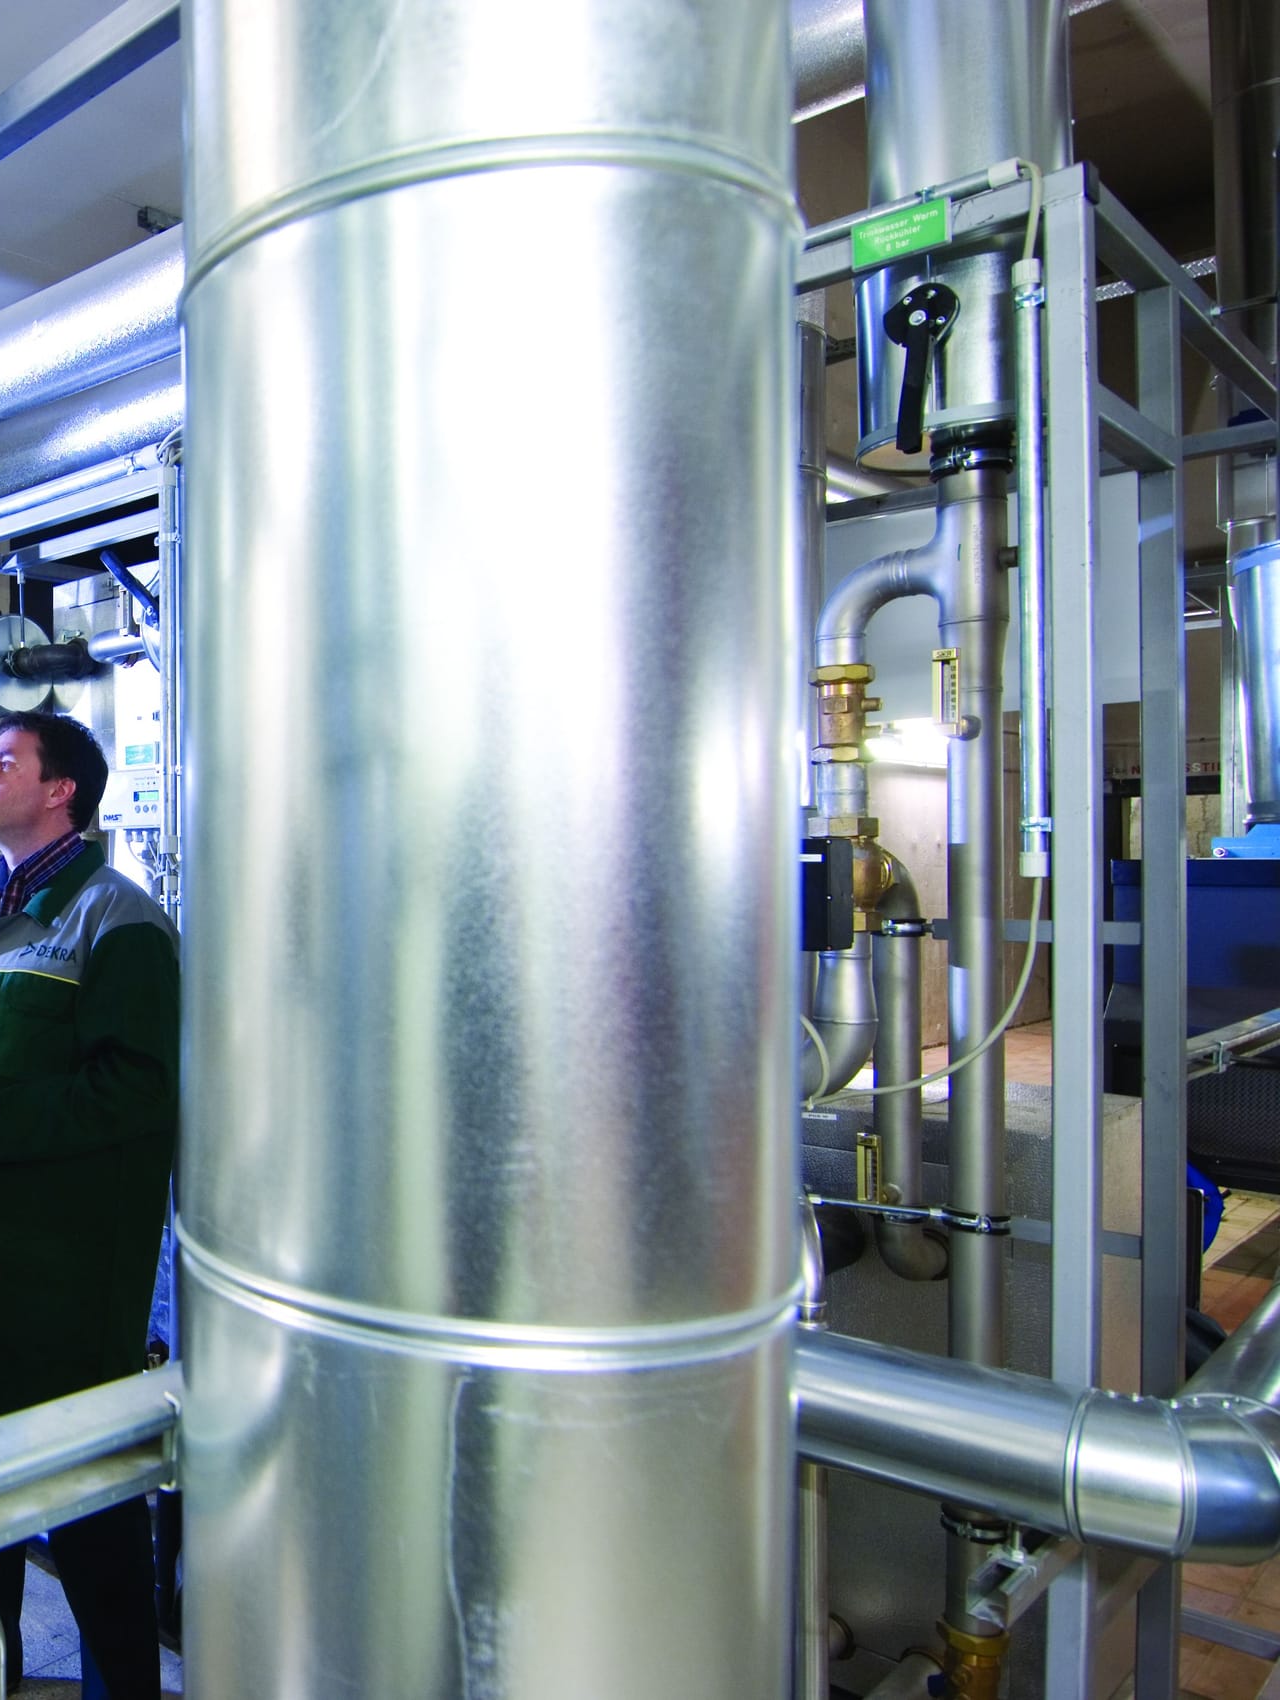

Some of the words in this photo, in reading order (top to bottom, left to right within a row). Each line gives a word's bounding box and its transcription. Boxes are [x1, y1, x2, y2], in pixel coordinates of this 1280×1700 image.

[912, 209, 938, 222] Warm
[896, 239, 910, 249] bar
[36, 944, 77, 963] DEKRA
